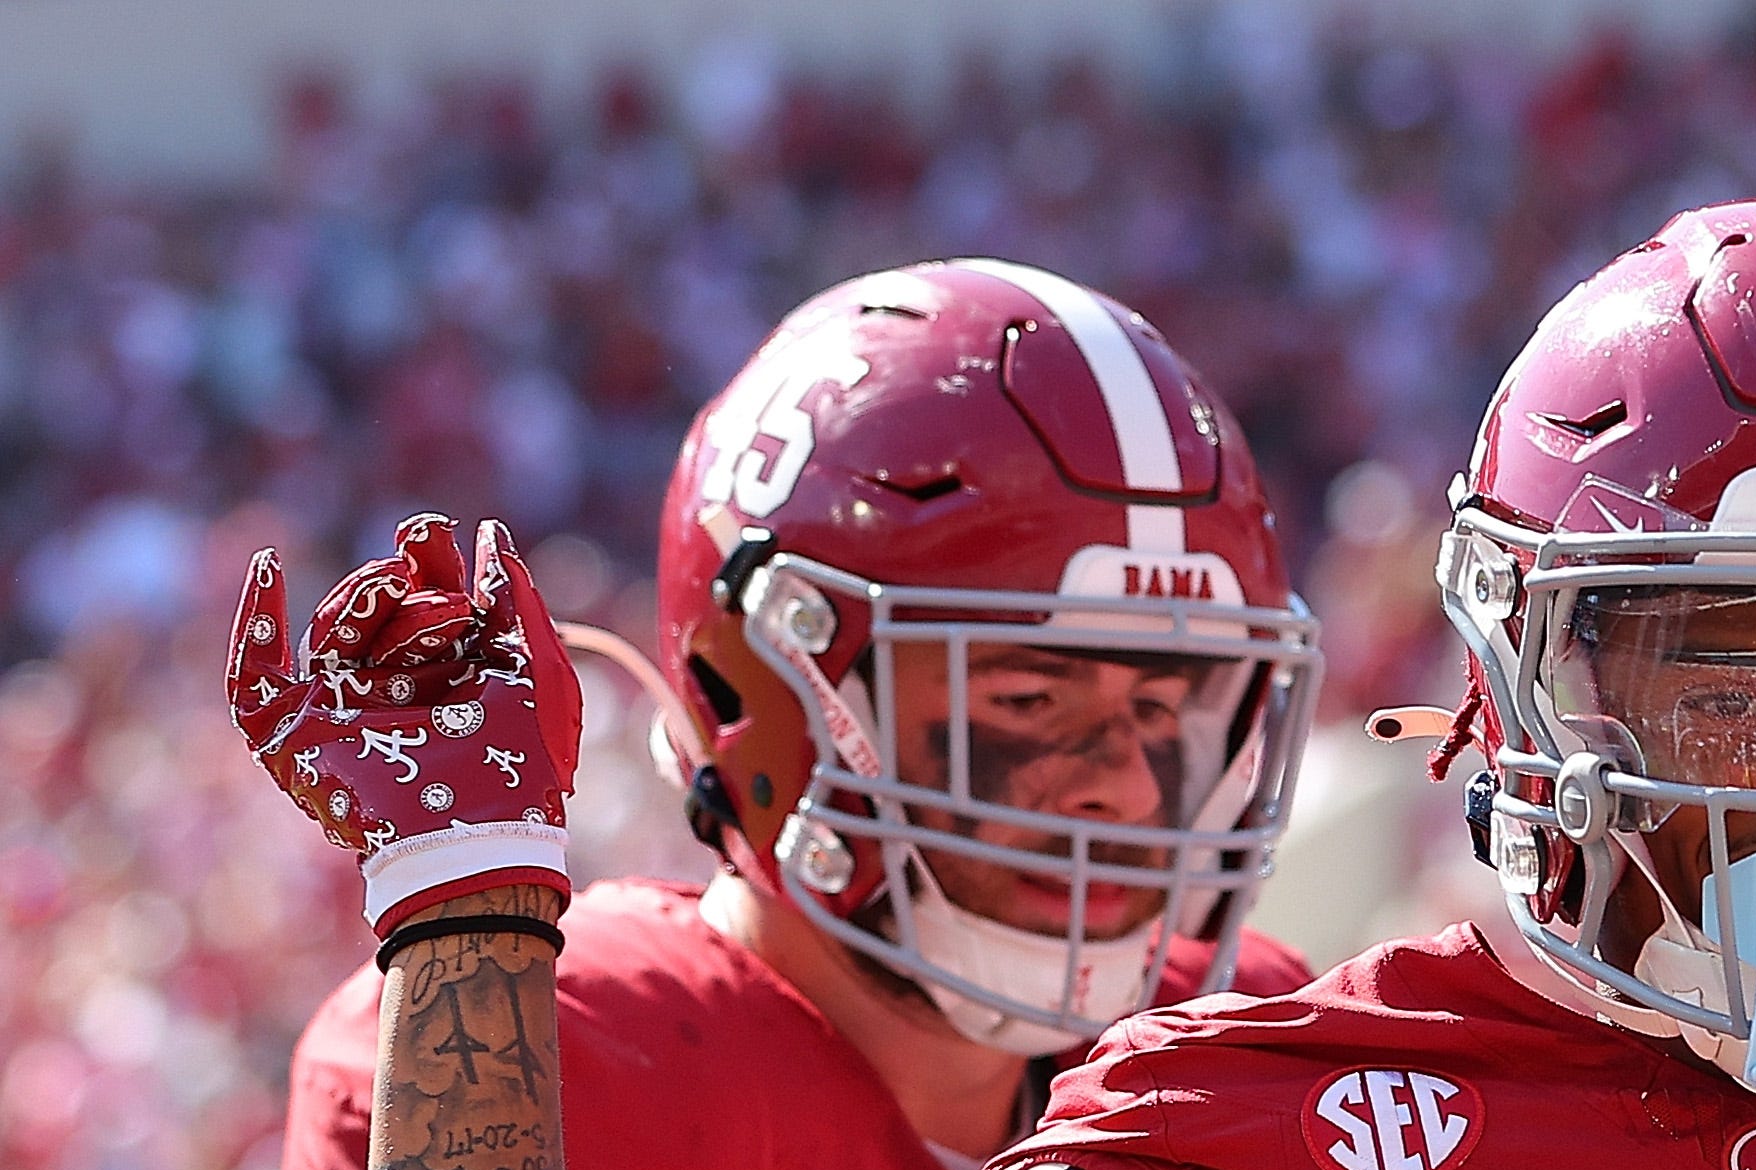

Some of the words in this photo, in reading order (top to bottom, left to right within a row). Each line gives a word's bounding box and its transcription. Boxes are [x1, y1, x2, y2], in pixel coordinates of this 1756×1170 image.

[704, 314, 872, 519] 45
[1123, 565, 1215, 600] BAMA
[357, 727, 428, 783] A
[483, 745, 526, 788] A
